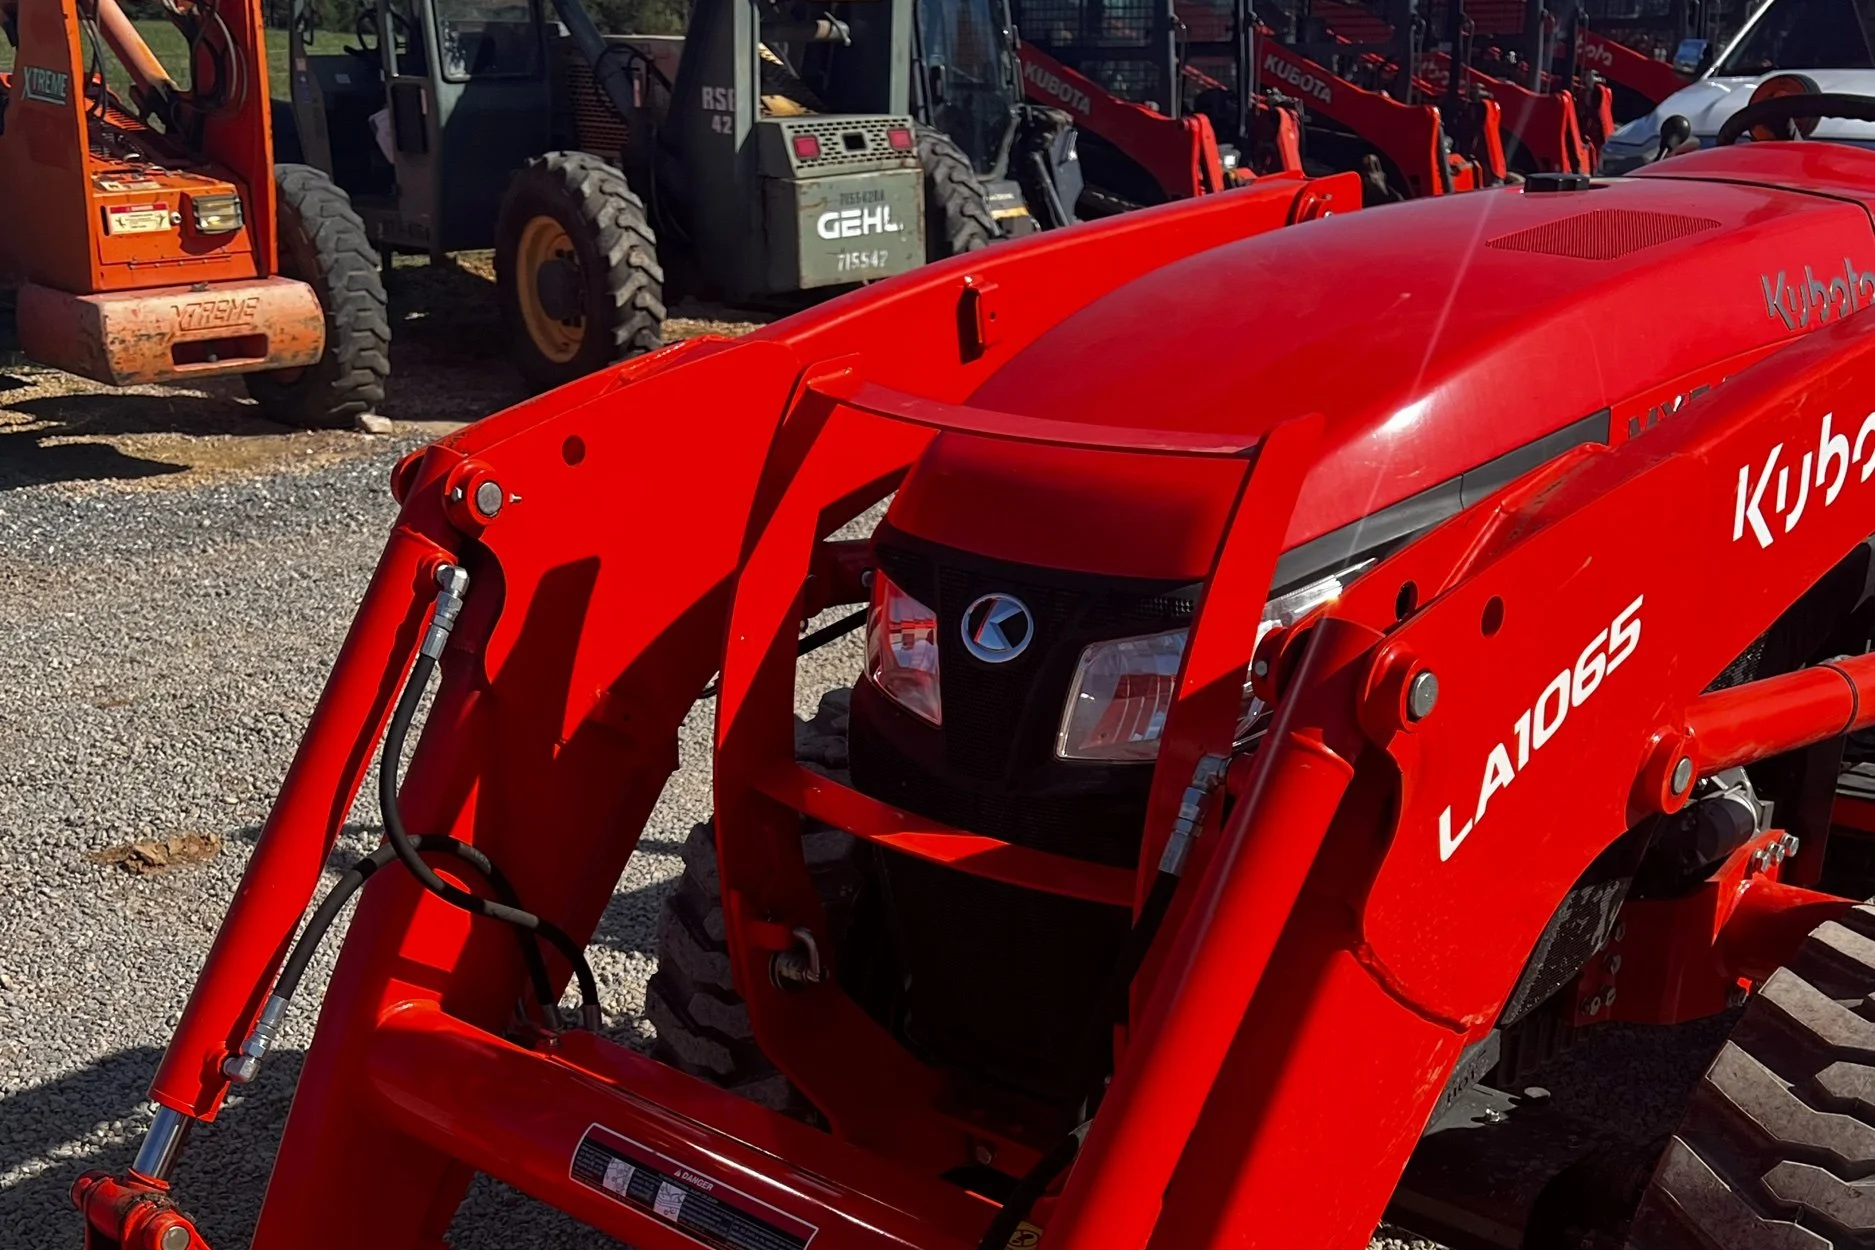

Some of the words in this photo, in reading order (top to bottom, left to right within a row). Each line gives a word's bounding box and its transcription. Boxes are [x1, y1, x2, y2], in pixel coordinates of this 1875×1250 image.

[21, 66, 68, 104] XTREME
[1024, 60, 1091, 116] KUBOTA
[1264, 53, 1333, 104] KUBOTA
[711, 115, 733, 135] 42
[817, 205, 904, 240] GEHL
[169, 297, 260, 333] XTREME
[1438, 593, 1644, 862] LA1065
[681, 1170, 715, 1191] DANGER
